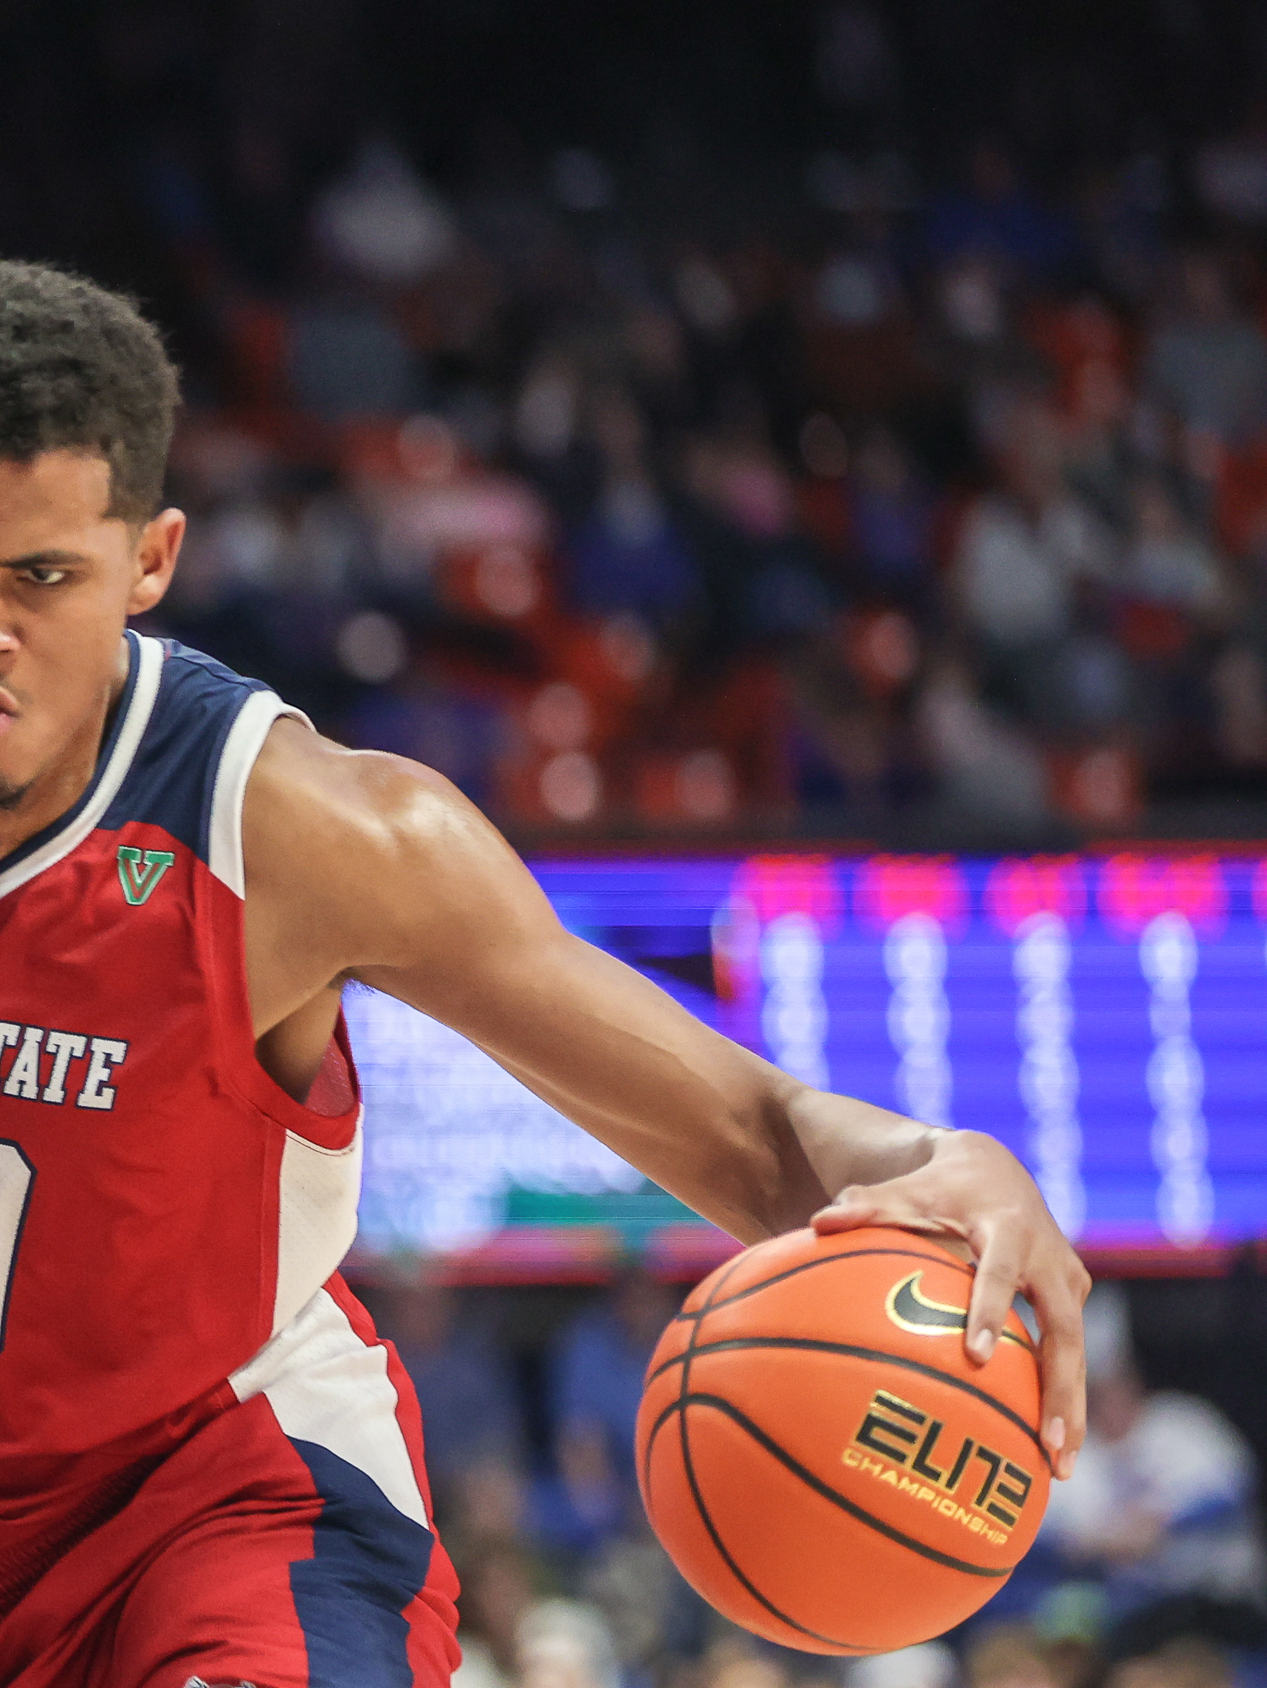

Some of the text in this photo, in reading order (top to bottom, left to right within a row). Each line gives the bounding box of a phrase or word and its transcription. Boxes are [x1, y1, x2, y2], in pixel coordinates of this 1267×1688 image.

[116, 845, 176, 906] V
[841, 1447, 1009, 1546] CHAMPIONSHIP
[853, 1388, 1033, 1532] ELITE
